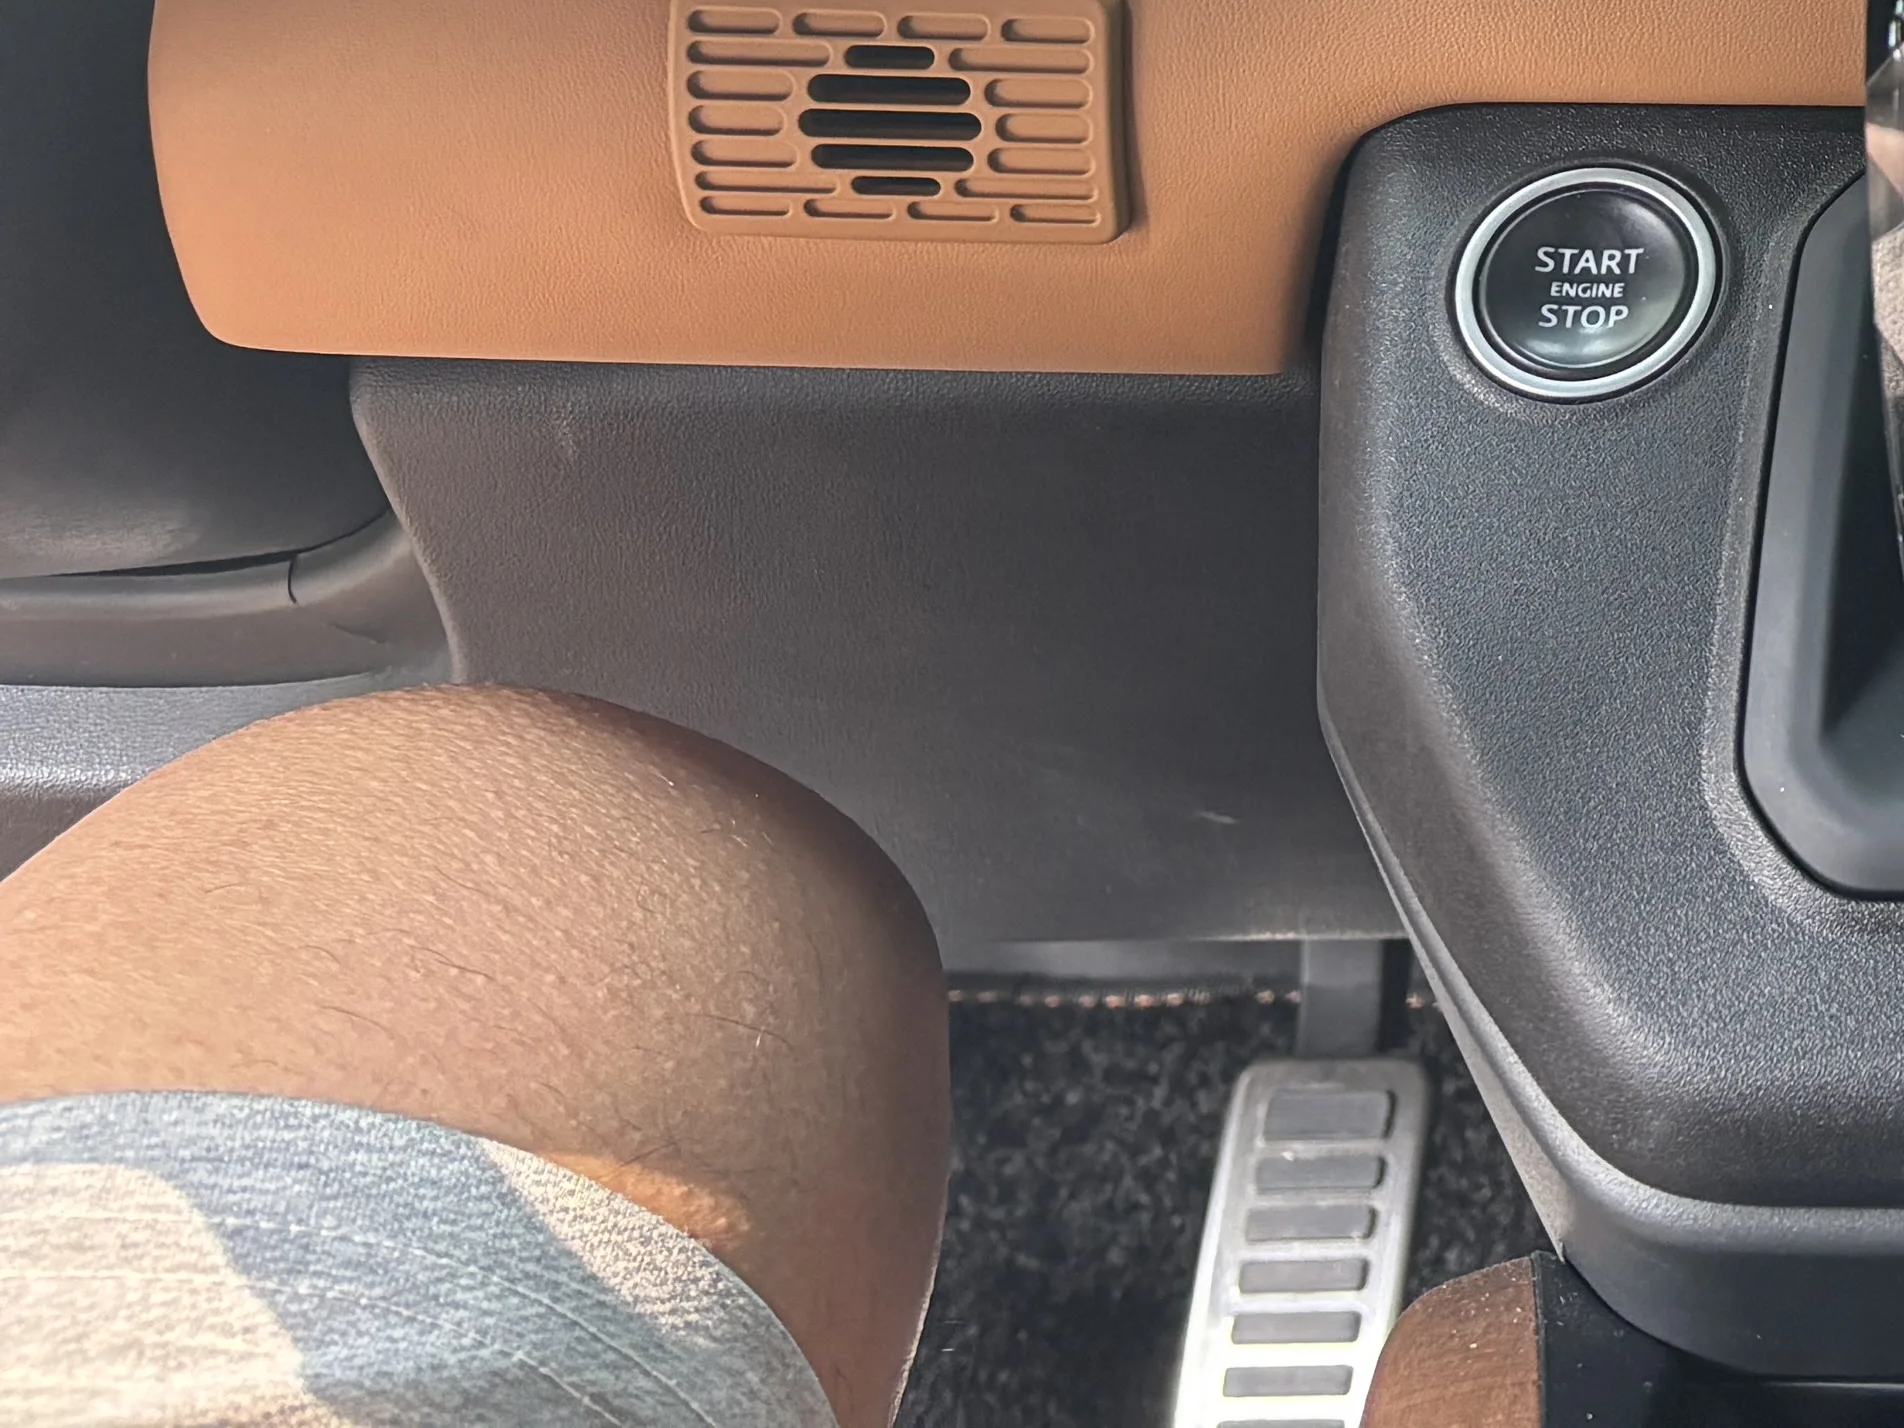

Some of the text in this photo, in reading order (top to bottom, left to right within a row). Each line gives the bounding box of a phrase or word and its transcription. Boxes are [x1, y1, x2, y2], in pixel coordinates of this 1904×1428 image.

[1534, 246, 1645, 275] START
[1550, 281, 1625, 298] ENGINE
[1538, 304, 1629, 329] STOP
